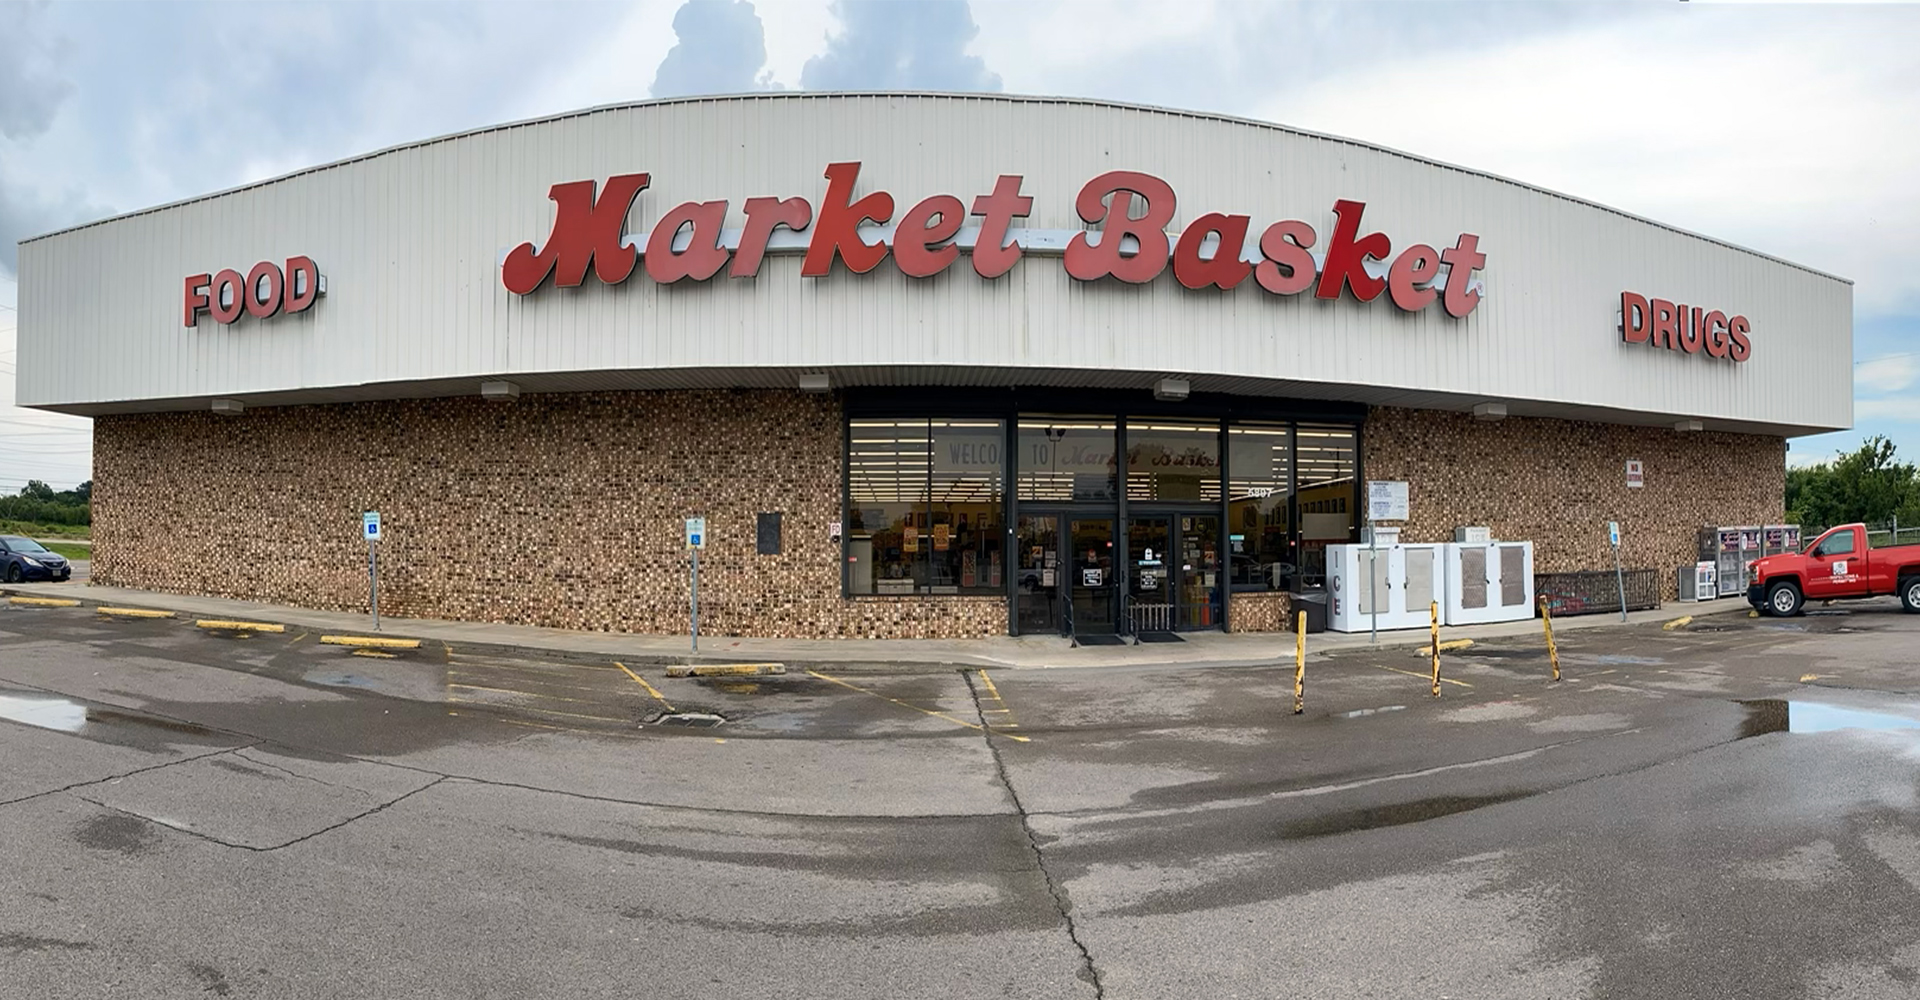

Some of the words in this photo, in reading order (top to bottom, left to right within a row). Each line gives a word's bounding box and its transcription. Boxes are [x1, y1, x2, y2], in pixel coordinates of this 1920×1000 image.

[502, 161, 1035, 296] Market
[1063, 170, 1487, 319] Basket
[183, 255, 320, 328] FOOD
[1621, 291, 1752, 363] DRUGS
[949, 443, 1002, 465] WELCO
[1032, 443, 1048, 465] TO
[1333, 551, 1341, 616] ICE
